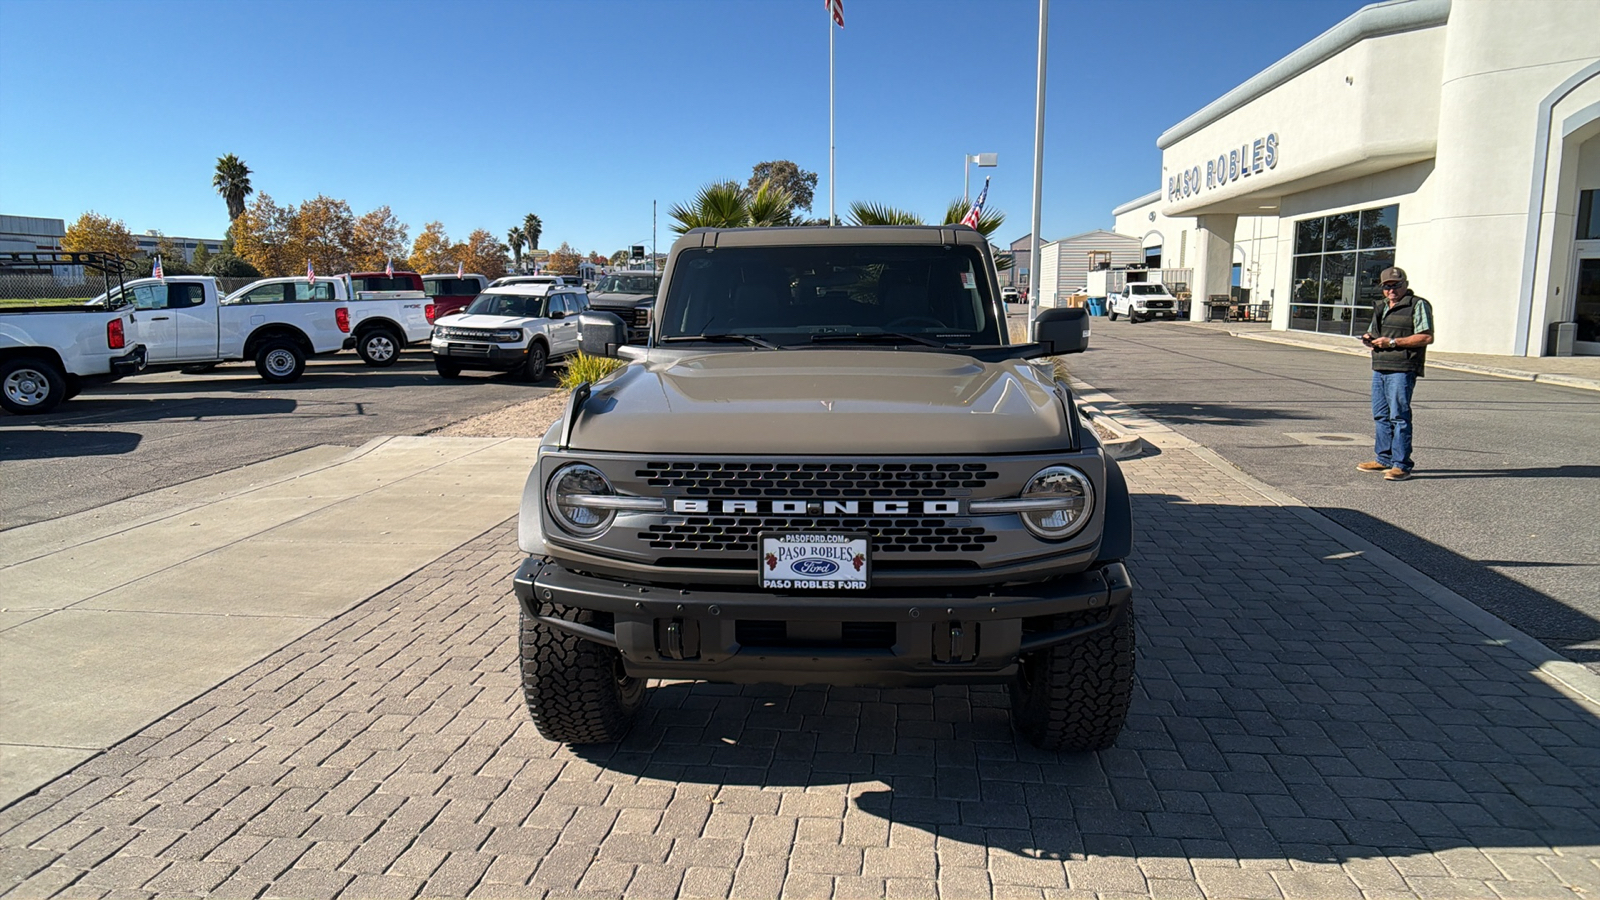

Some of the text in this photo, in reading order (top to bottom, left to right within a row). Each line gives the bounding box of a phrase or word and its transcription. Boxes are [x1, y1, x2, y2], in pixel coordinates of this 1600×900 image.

[1168, 132, 1279, 202] PASO ROBLES
[673, 499, 959, 514] BRONCO
[785, 534, 844, 543] PASOFORD.COM
[778, 546, 853, 562] PASO ROBLES
[801, 561, 830, 573] Ford
[763, 580, 867, 590] PASO ROBLES FORD
